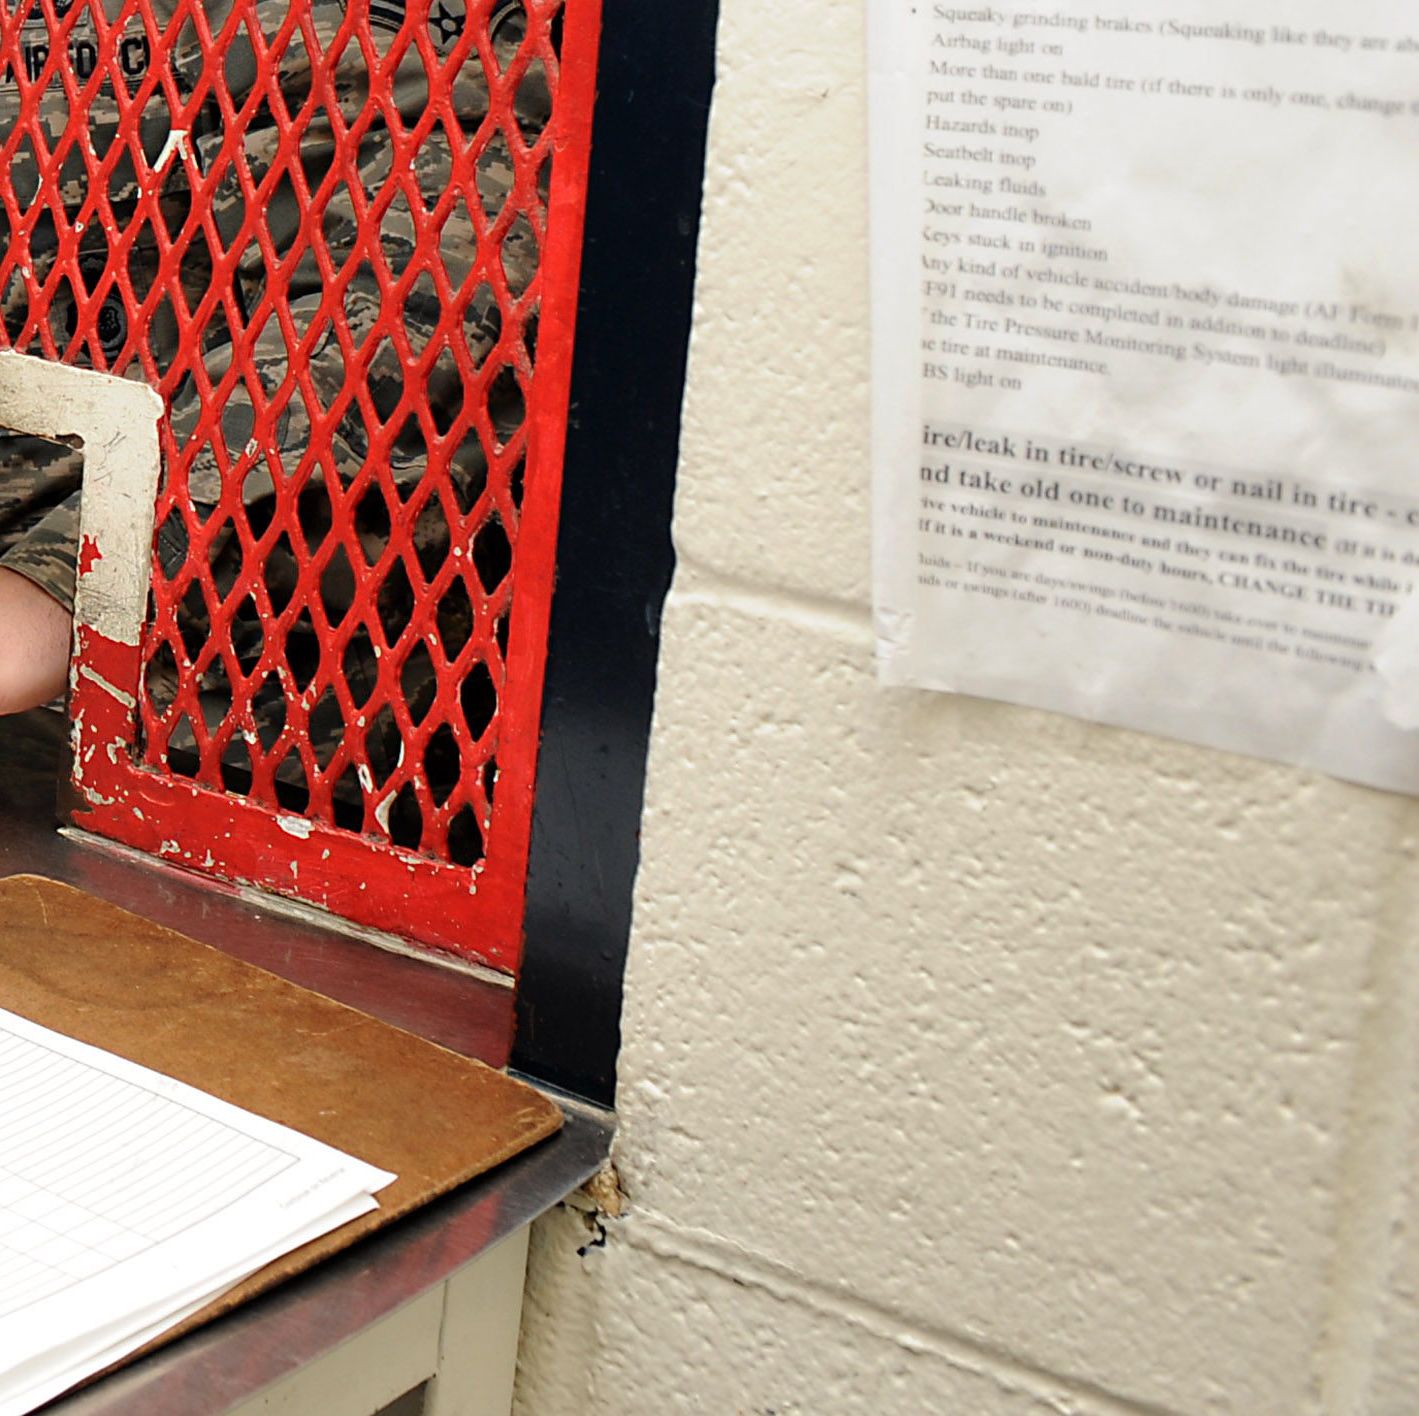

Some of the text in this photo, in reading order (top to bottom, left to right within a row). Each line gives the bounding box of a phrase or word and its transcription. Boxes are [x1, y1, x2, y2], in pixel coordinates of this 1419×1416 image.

[932, 33, 1063, 56] Airbag light on
[927, 90, 1073, 115] put the spare on)
[930, 60, 1406, 118] More than one bald tire (if there is only one, change
[925, 115, 1040, 143] Hazards inop
[923, 142, 1036, 171] Seatbelt inop
[999, 177, 1046, 198] fluids
[969, 203, 1027, 223] handle
[1031, 209, 1091, 231] broken
[968, 235, 1011, 249] stuck
[1019, 241, 1034, 252] in
[1042, 242, 1108, 262] ignition
[957, 258, 995, 276] kind
[1001, 265, 1020, 279] of
[1026, 268, 1088, 287] vehicle
[1225, 293, 1299, 317] damage
[964, 290, 1014, 306] needs
[1018, 294, 1037, 307] to
[1043, 294, 1063, 312] be
[1069, 304, 1159, 325] completed
[1166, 316, 1183, 328] in
[1189, 317, 1266, 339] addition
[1270, 328, 1289, 342] to
[1294, 330, 1386, 357] deadline)
[928, 309, 957, 326] the
[964, 313, 998, 331] Tire
[1005, 318, 1079, 343] Pressure
[1085, 329, 1187, 361] Monitoring
[1193, 344, 1259, 368] System
[1267, 354, 1308, 376] light
[941, 340, 969, 355] tire
[975, 346, 990, 358] at
[954, 367, 993, 387] light
[999, 377, 1022, 390] on
[923, 425, 1378, 518] ire/leak in tire/screw or nail in tire
[920, 465, 1326, 550] nd take old one to maintenance
